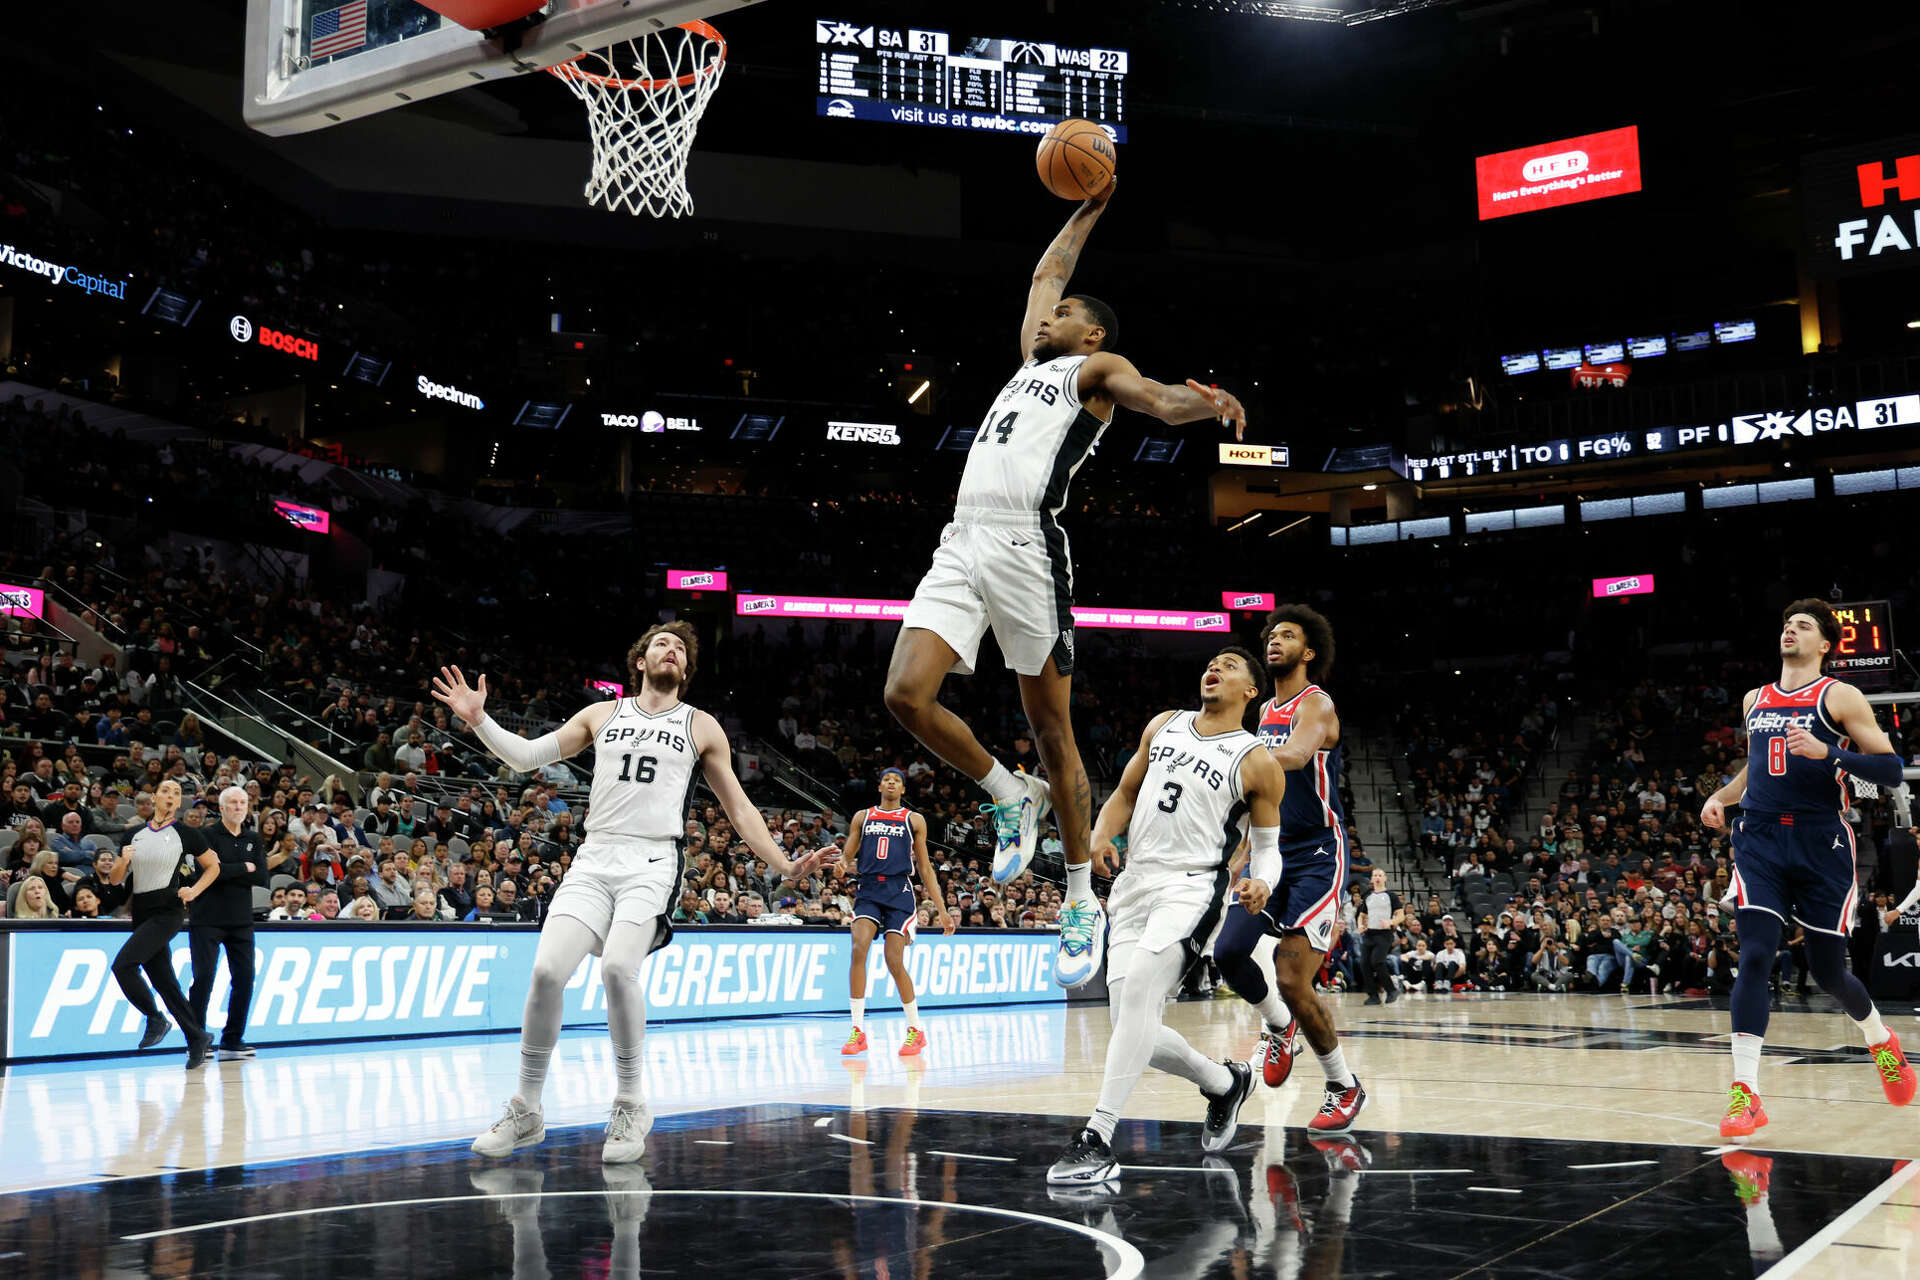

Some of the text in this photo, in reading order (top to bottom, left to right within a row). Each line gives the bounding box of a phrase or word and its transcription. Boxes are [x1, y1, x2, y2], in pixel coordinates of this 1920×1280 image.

[876, 50, 892, 58] PTS
[879, 30, 936, 52] SA 31
[1056, 48, 1119, 70] WAS 22
[890, 107, 1055, 134] visit us at swbc.com
[1492, 170, 1623, 201] Here Everything's Better
[259, 326, 318, 361] BOSCH
[417, 375, 480, 410] Spectrum
[601, 414, 700, 431] TACO BELL
[978, 410, 1019, 444] 14
[1814, 402, 1898, 431] SA 31
[1229, 450, 1266, 459] HOLT
[1520, 446, 1552, 463] TO
[1578, 436, 1631, 457] FG%
[1678, 426, 1710, 445] PF
[1408, 449, 1507, 468] REB AST STL BLK
[1839, 626, 1880, 654] 21
[1848, 657, 1891, 666] TISSOT
[1749, 712, 1815, 730] district
[619, 754, 658, 783] 16
[1768, 736, 1786, 776] 8
[1158, 781, 1182, 814] 3
[877, 837, 889, 859] 0
